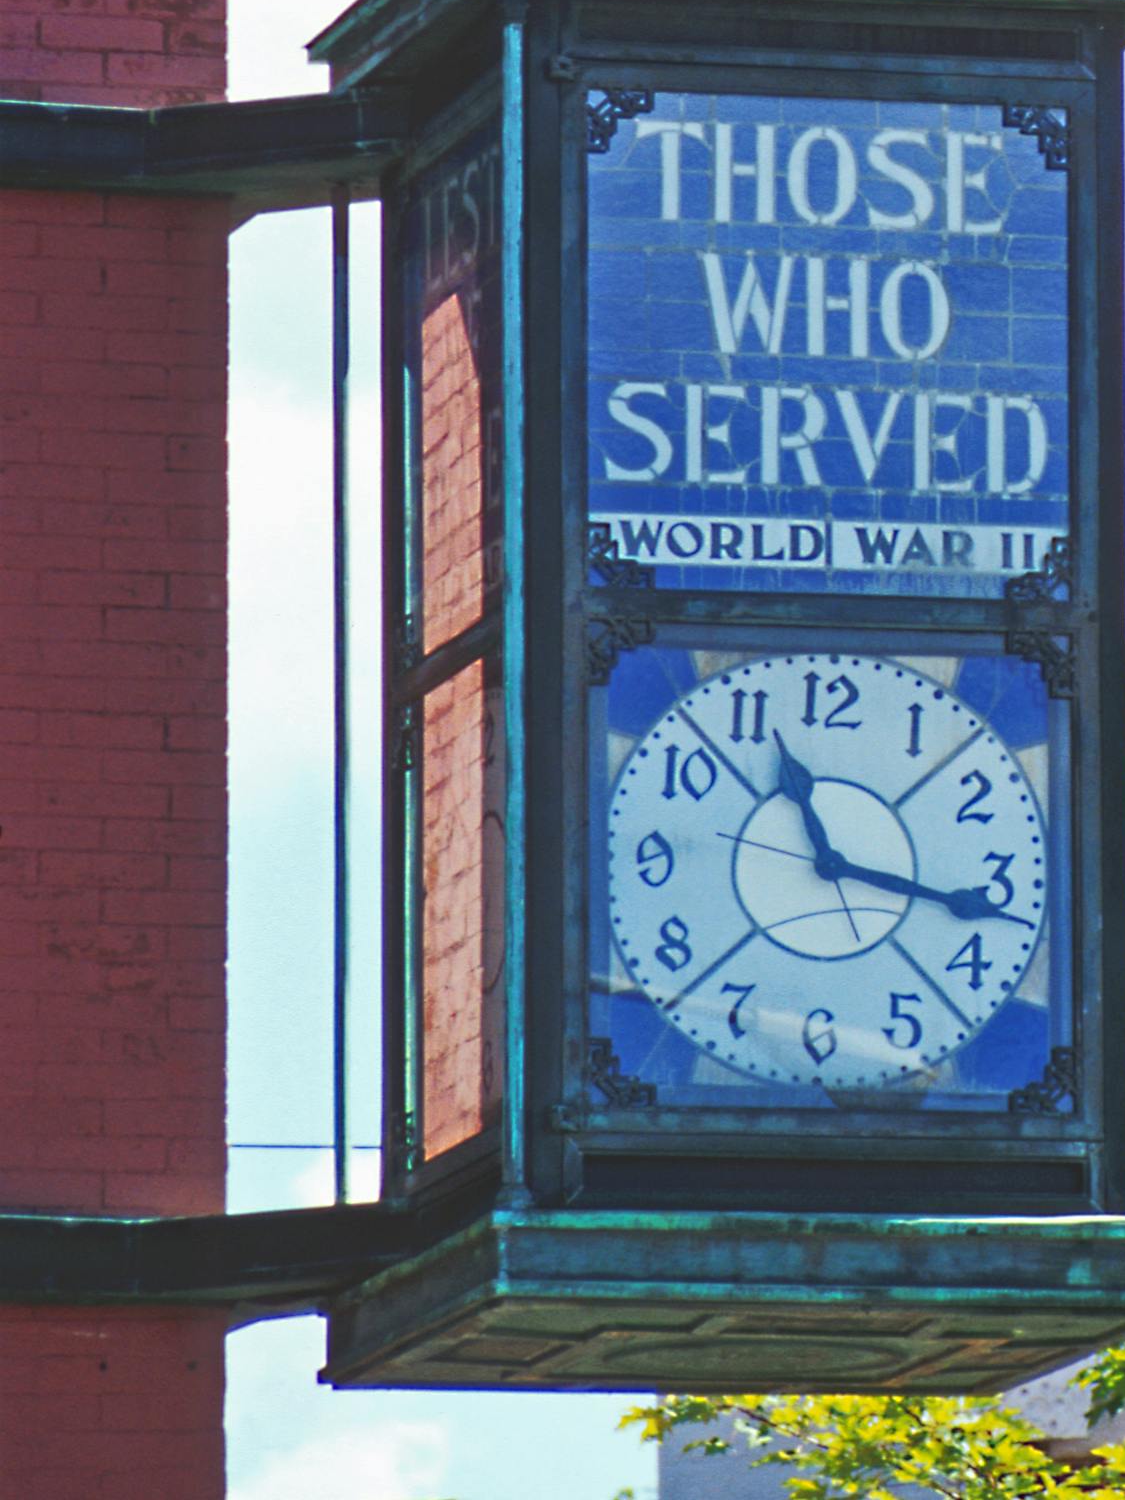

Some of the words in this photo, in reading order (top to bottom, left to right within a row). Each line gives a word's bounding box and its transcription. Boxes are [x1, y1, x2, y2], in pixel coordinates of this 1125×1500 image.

[636, 121, 1003, 233] THOSE
[703, 252, 950, 360] WHO
[605, 382, 1048, 494] SERVED
[619, 519, 825, 562] WORLD
[855, 526, 975, 568] WAR
[1001, 532, 1036, 570] II
[729, 688, 769, 745] 11
[802, 671, 862, 729] 12
[906, 702, 924, 759] 1
[661, 744, 717, 800] 10
[956, 769, 995, 824] 2
[636, 831, 675, 887] 9
[974, 851, 1015, 911] 3
[654, 915, 692, 972] 8
[945, 932, 993, 992] 4
[720, 981, 757, 1039] 7
[802, 1008, 837, 1066] 6
[882, 992, 923, 1049] 5
